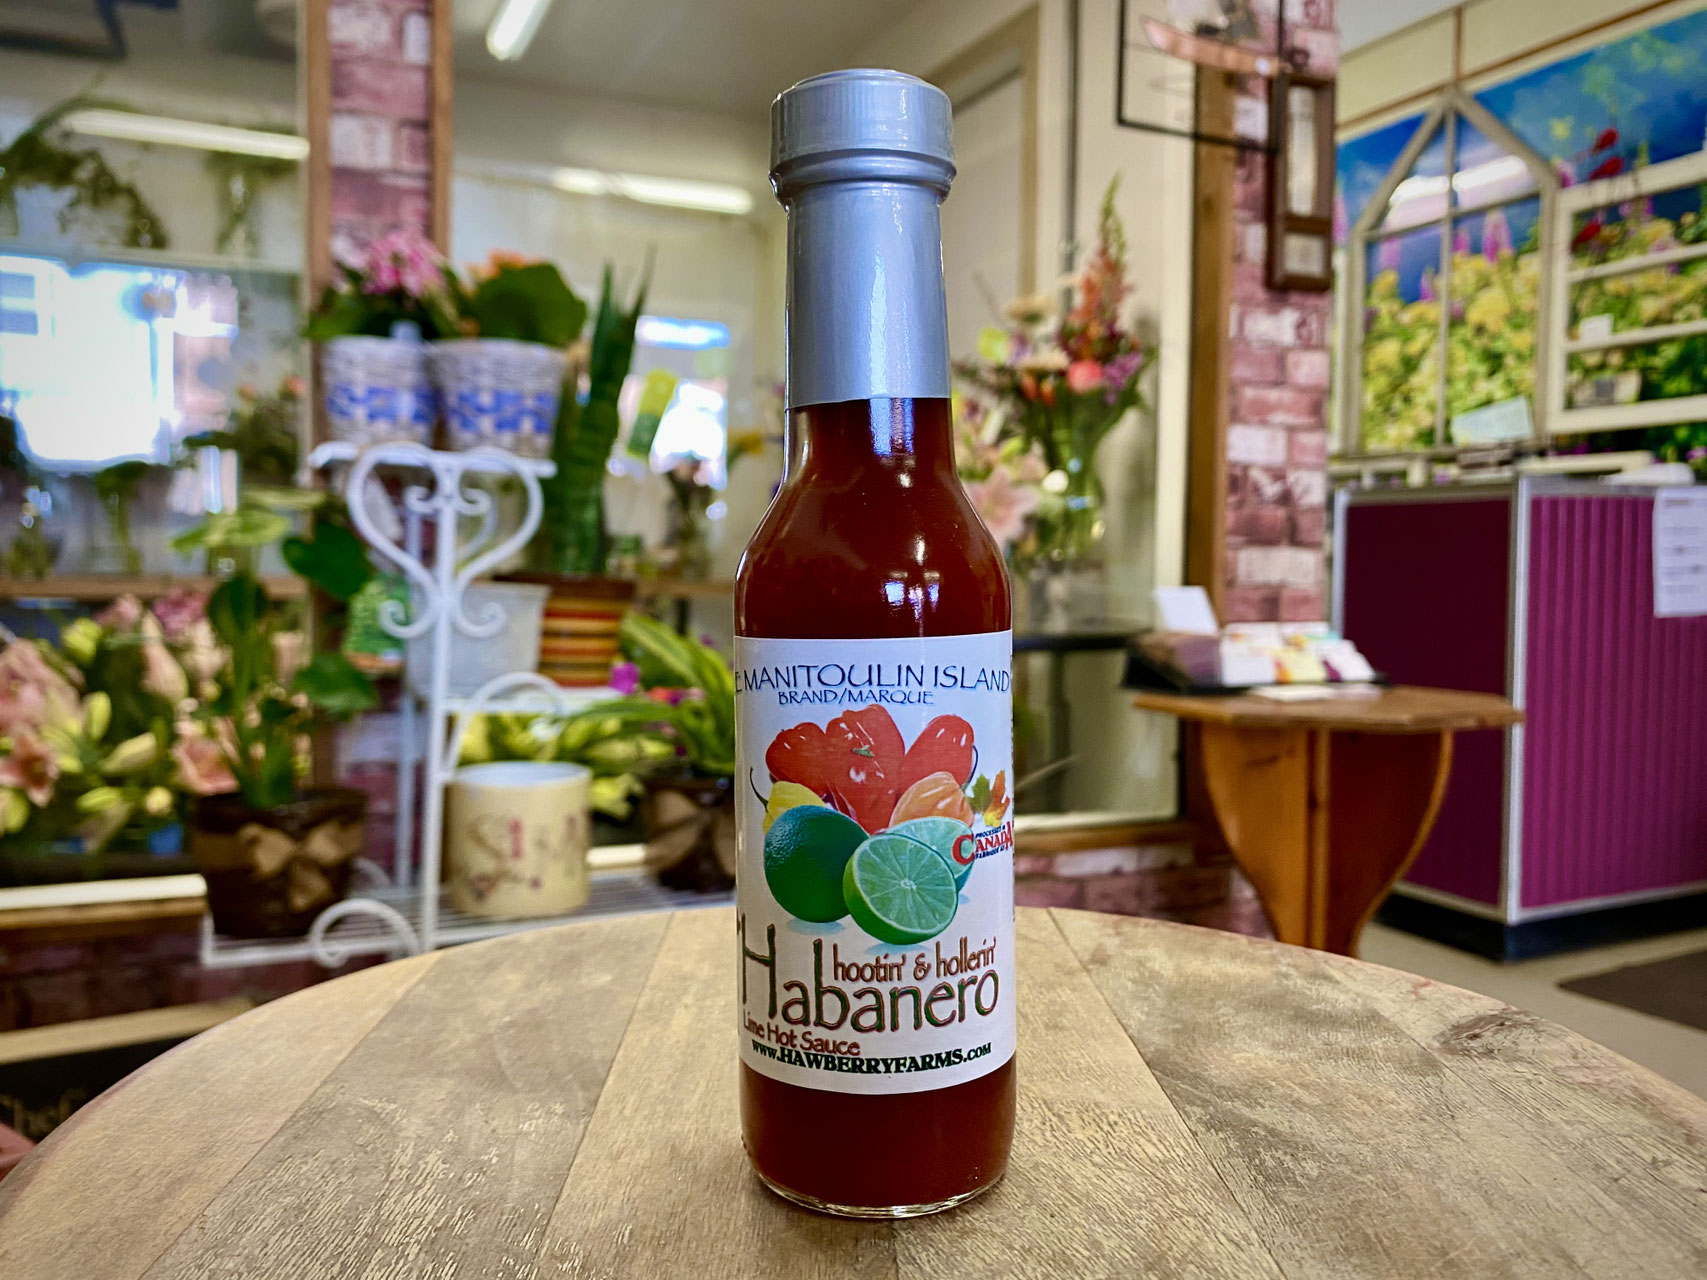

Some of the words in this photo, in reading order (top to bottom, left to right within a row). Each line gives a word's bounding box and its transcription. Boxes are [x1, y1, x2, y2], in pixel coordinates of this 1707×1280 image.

[744, 664, 924, 691] MANITOULIN
[934, 665, 1009, 691] ISLAND
[778, 687, 934, 705] BRAND/MARQUE
[952, 821, 1013, 865] CANADA
[742, 912, 999, 1034] Habanero
[833, 943, 907, 982] hootin'
[914, 952, 932, 981] &
[936, 936, 997, 978] hollerin'
[743, 1008, 765, 1038] Lime
[767, 1022, 797, 1048] Hot
[800, 1031, 861, 1056] Sauce
